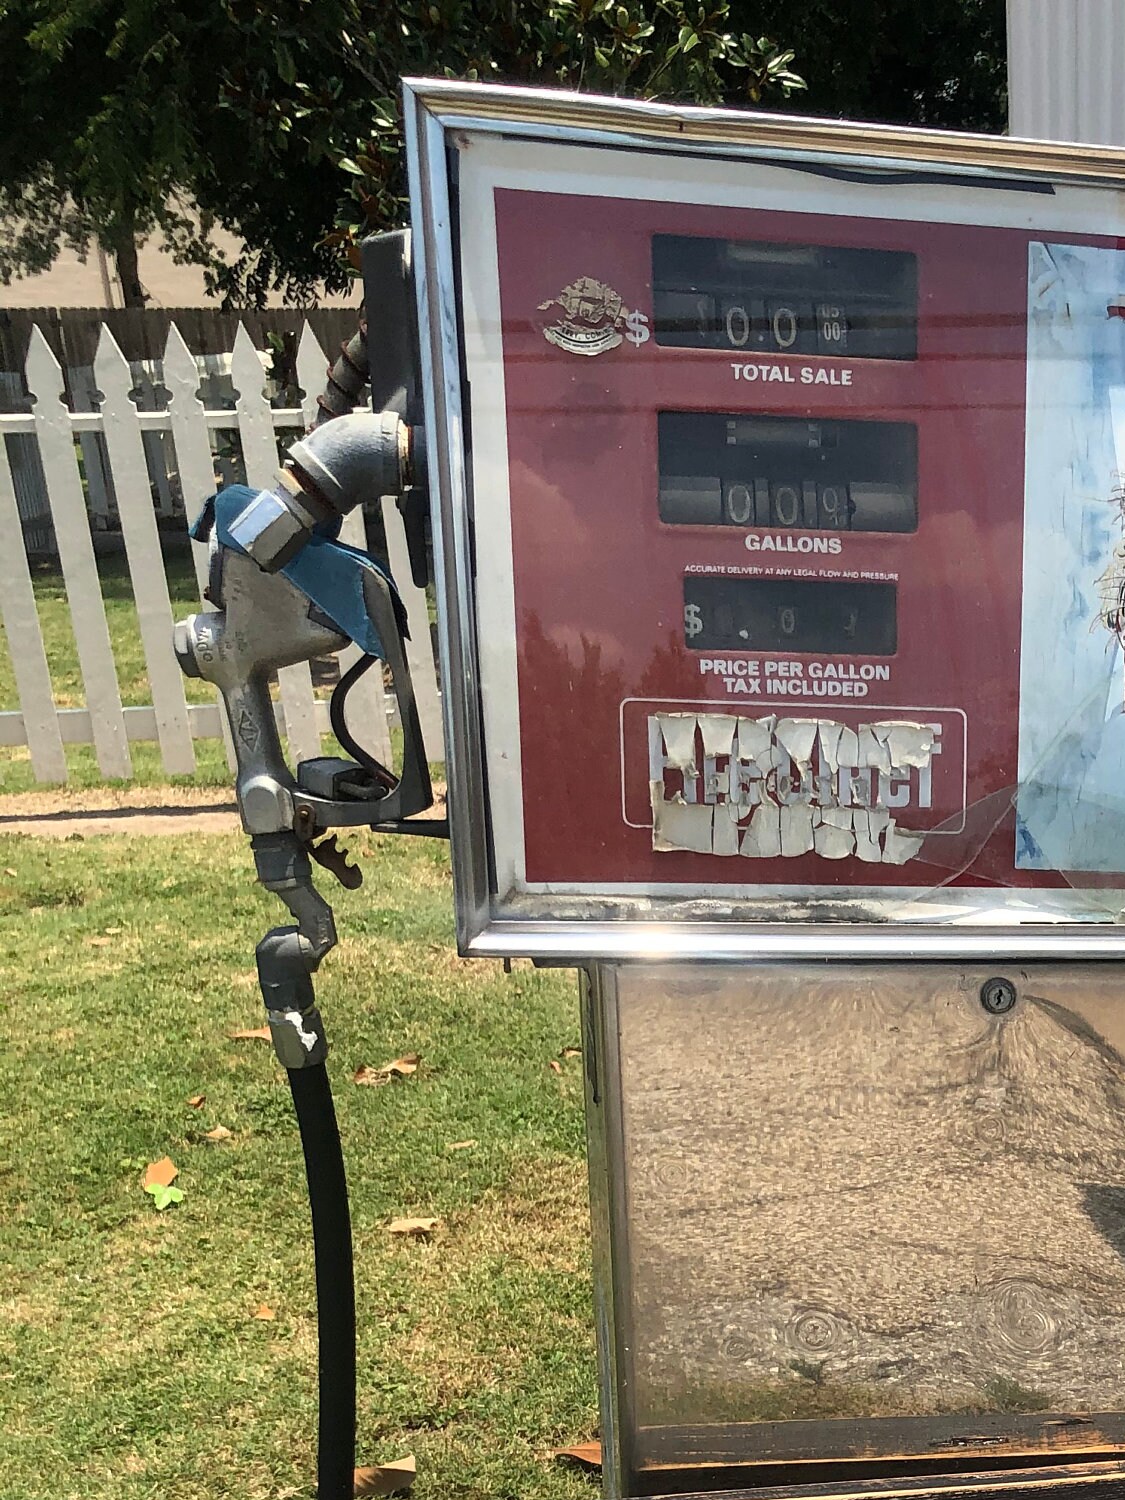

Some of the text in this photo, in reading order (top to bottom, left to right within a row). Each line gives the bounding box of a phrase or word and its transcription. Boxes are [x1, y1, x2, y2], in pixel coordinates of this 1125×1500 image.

[626, 308, 649, 348] $
[730, 363, 853, 386] TOTAL SALE
[744, 534, 842, 555] GALLONS
[684, 564, 899, 581] ACCURATE DELIVERY AT ANY LEGAL FLOW AND PRESSURE
[684, 603, 704, 639] $
[699, 658, 891, 681] PRICE PER GALLON
[722, 676, 869, 697] TAX INCLUDED
